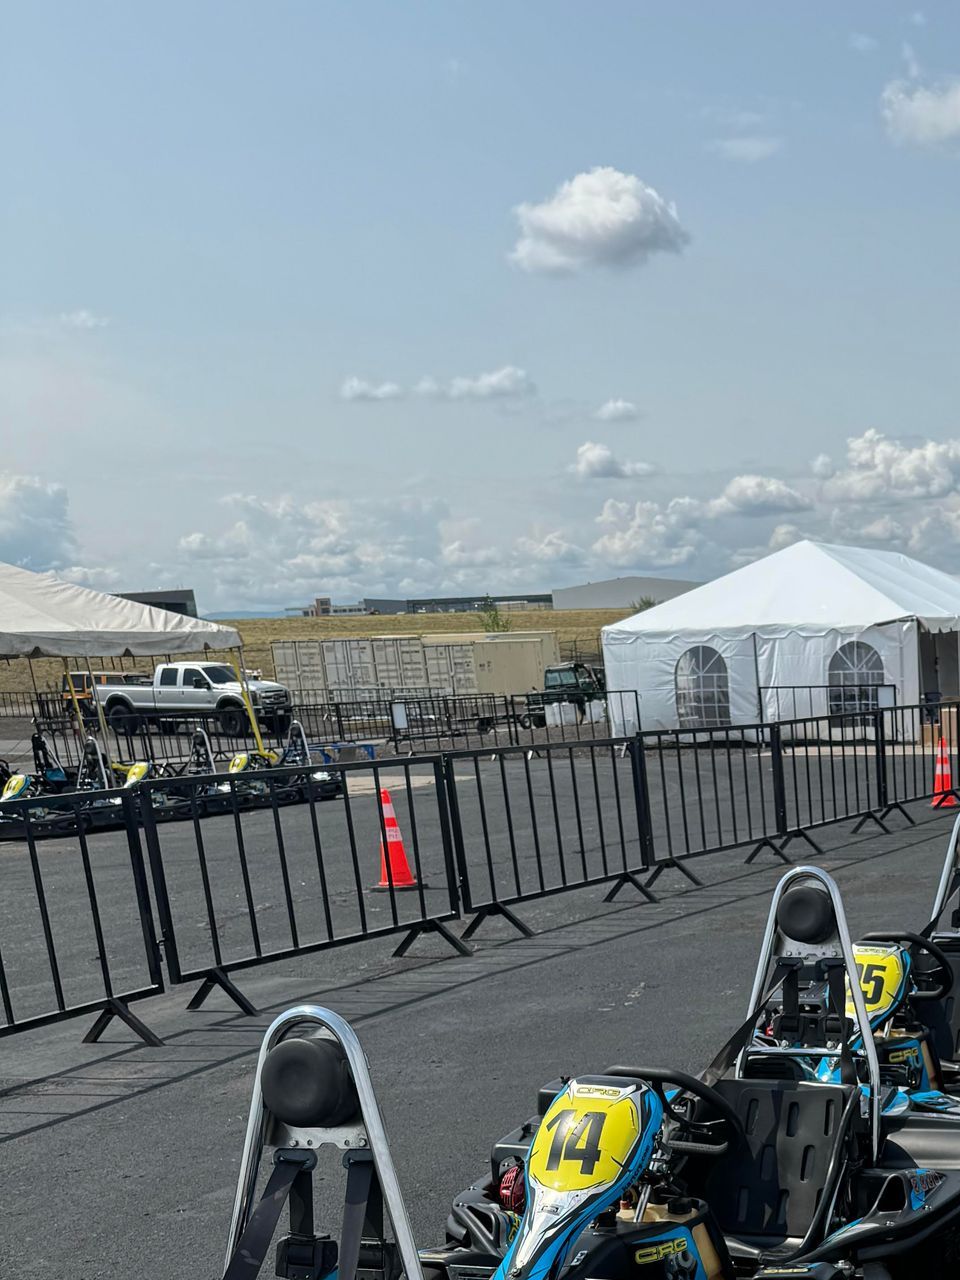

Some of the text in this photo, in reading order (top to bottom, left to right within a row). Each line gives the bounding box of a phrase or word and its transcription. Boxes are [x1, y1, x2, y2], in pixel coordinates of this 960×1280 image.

[576, 1086, 620, 1098] CRG
[546, 1109, 608, 1176] 14
[634, 1237, 689, 1265] CRG
